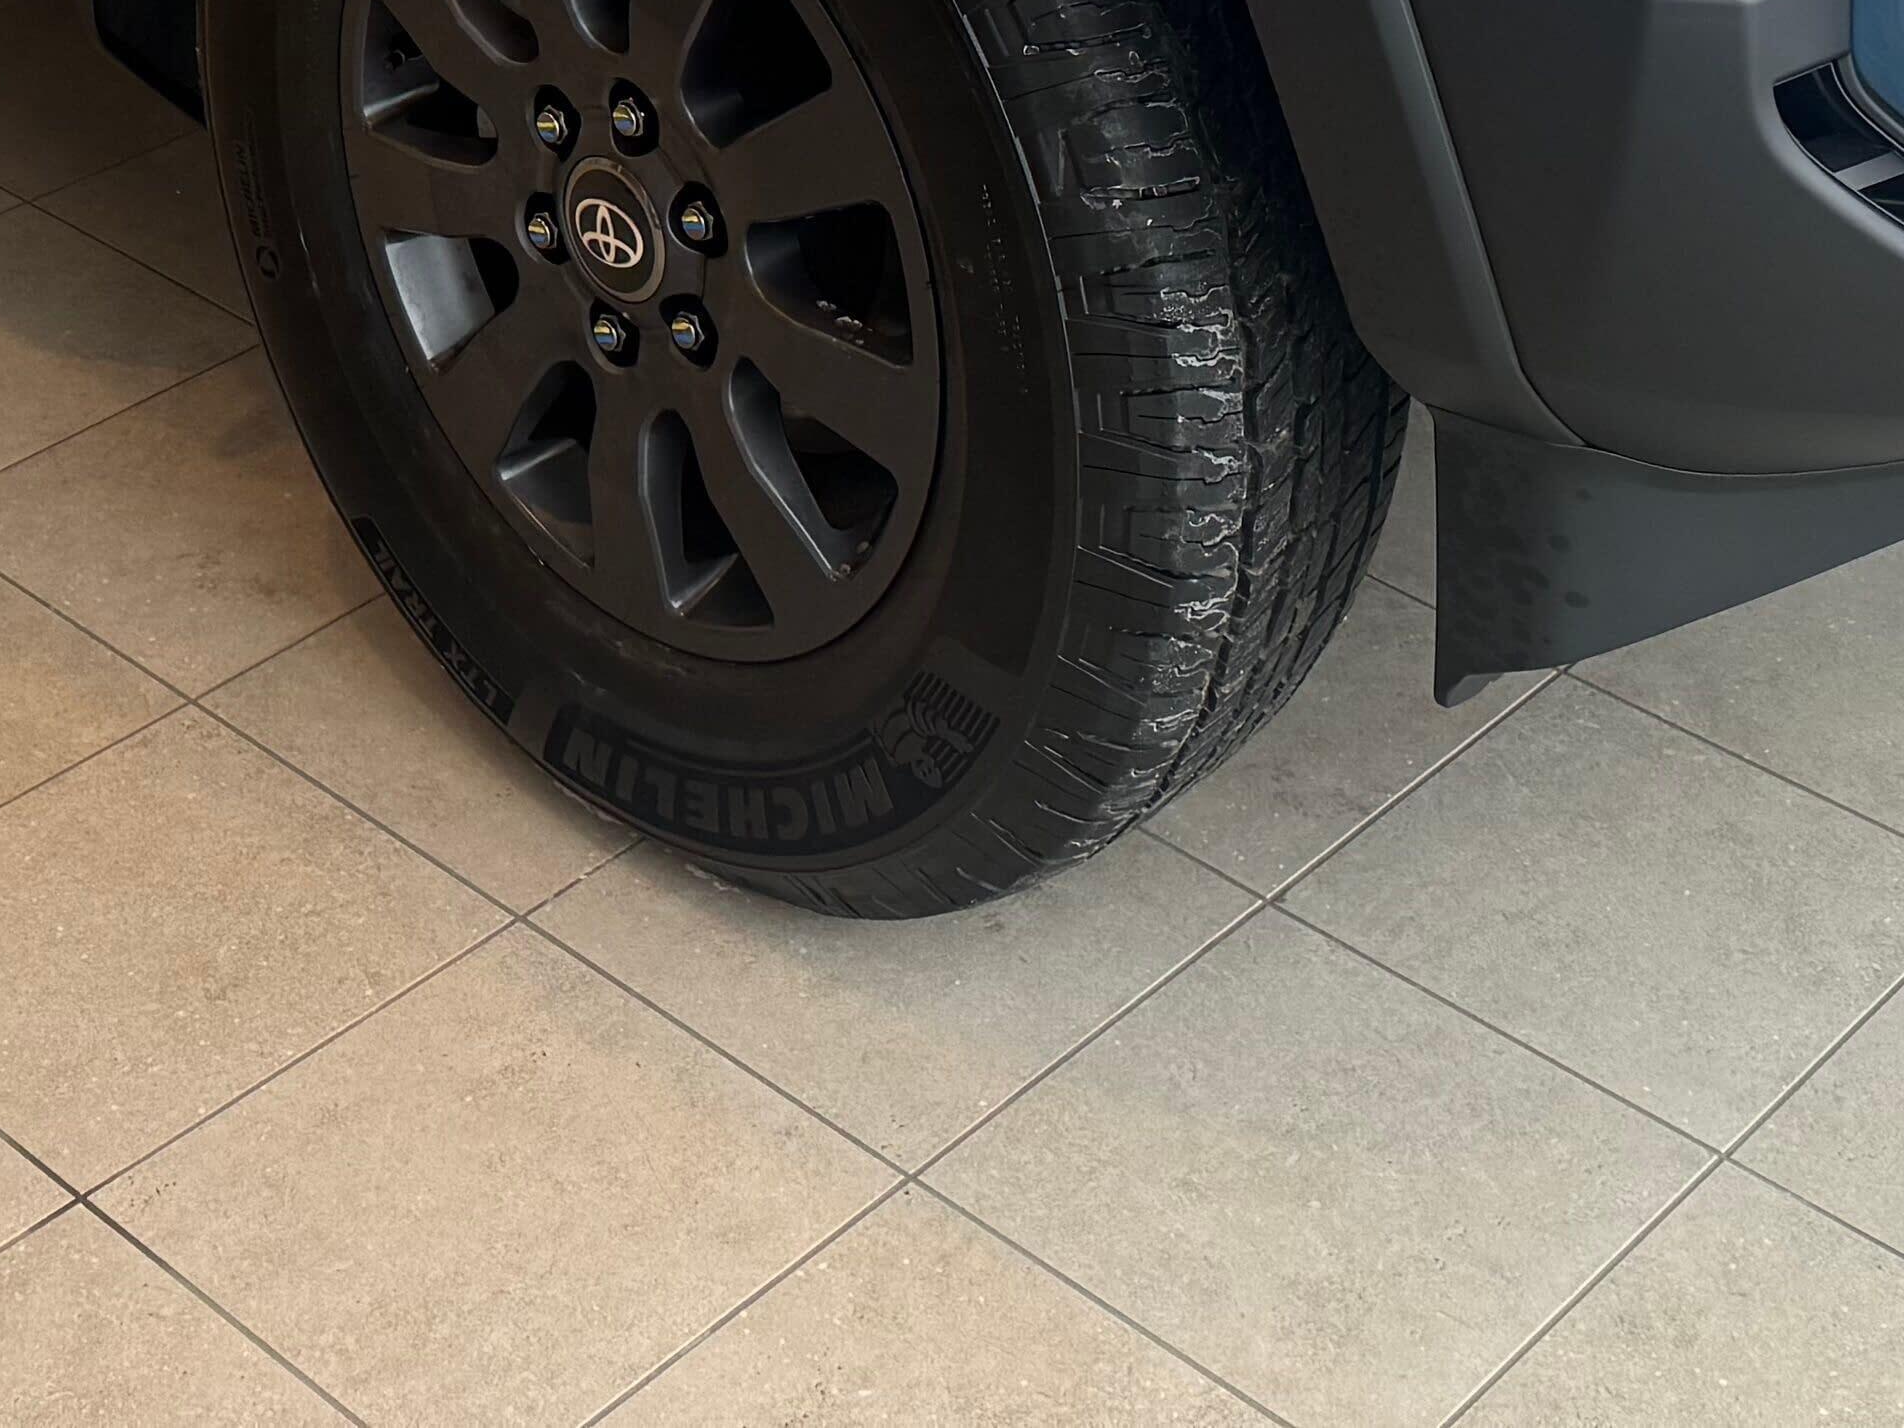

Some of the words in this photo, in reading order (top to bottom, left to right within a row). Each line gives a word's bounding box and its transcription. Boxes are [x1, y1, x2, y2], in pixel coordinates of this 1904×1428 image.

[372, 539, 438, 639] TRAIL
[442, 638, 498, 707] LTX
[562, 727, 894, 842] MICHELIN
